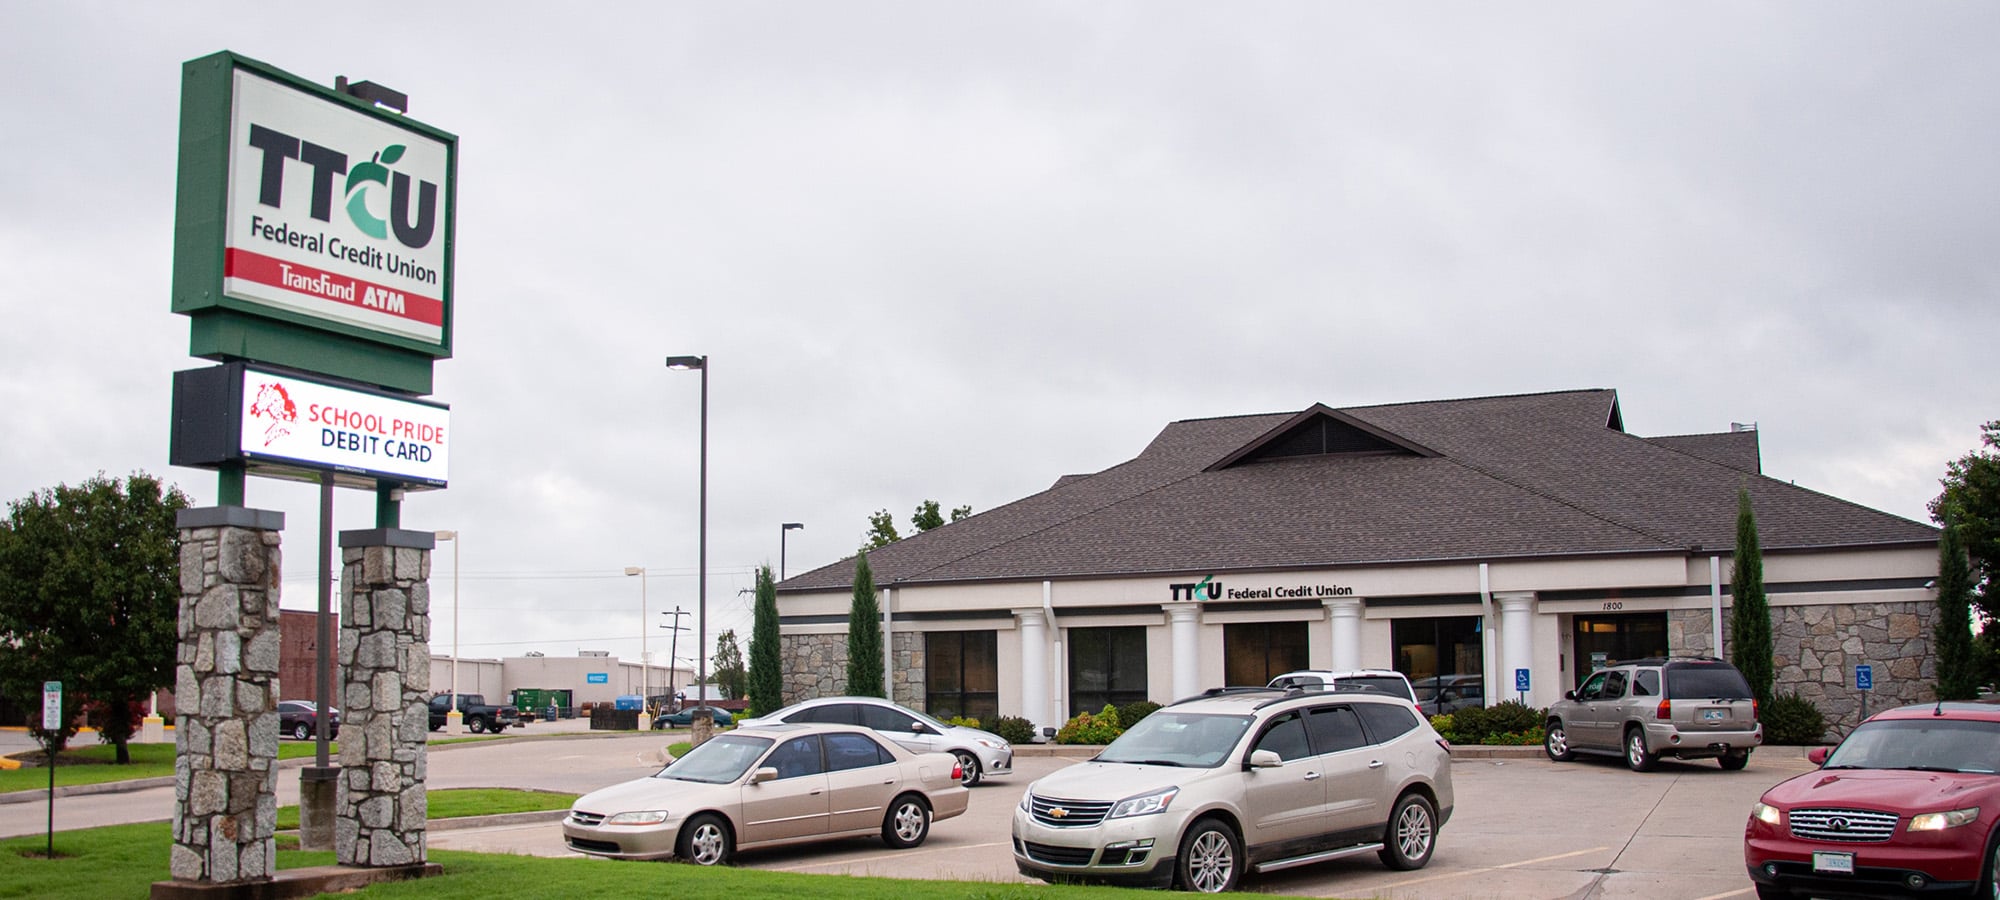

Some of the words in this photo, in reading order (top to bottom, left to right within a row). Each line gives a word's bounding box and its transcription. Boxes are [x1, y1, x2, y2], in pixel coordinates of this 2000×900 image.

[249, 123, 438, 249] TTCU
[251, 214, 324, 254] Federal
[328, 236, 383, 270] Credit
[387, 252, 437, 285] Union
[279, 263, 356, 302] TransFund
[362, 286, 406, 315] ATM
[308, 403, 387, 435] SCHOOL
[393, 418, 444, 445] PRIDE
[322, 428, 380, 455] DEBIT
[384, 439, 432, 463] CARD
[1169, 576, 1222, 601] TTCU
[1228, 587, 1272, 599] Federal
[1275, 585, 1312, 598] Credit
[1316, 584, 1353, 597] Union
[1602, 601, 1623, 610] 1800
